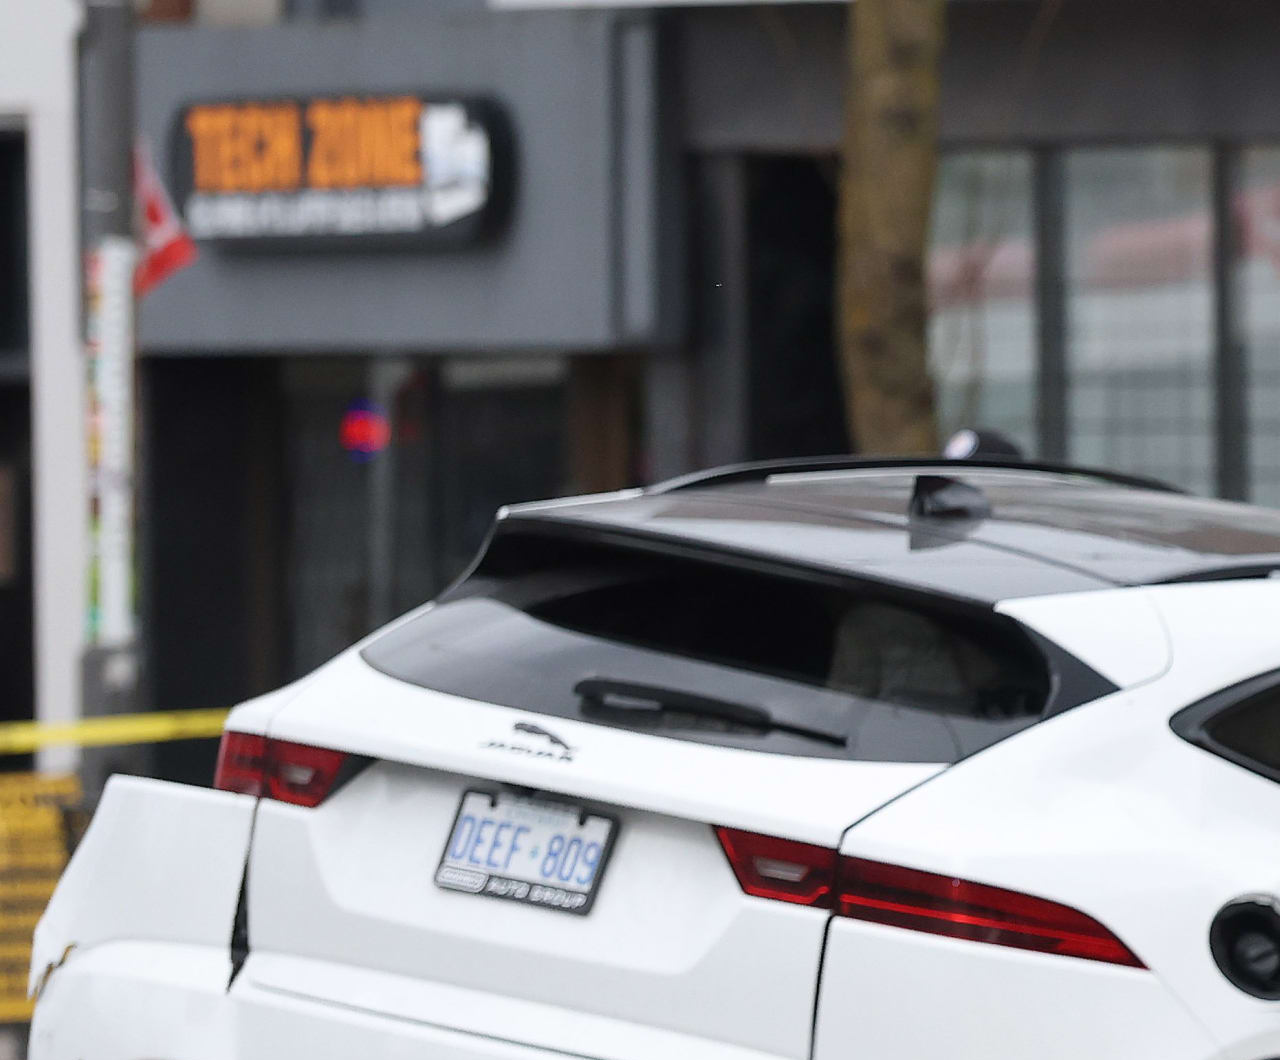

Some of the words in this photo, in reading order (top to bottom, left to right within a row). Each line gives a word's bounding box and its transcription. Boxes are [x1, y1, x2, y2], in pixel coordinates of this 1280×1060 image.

[186, 103, 301, 193] TECH
[306, 97, 424, 189] ZONE
[450, 815, 530, 869] DEEF
[540, 834, 604, 884] 809
